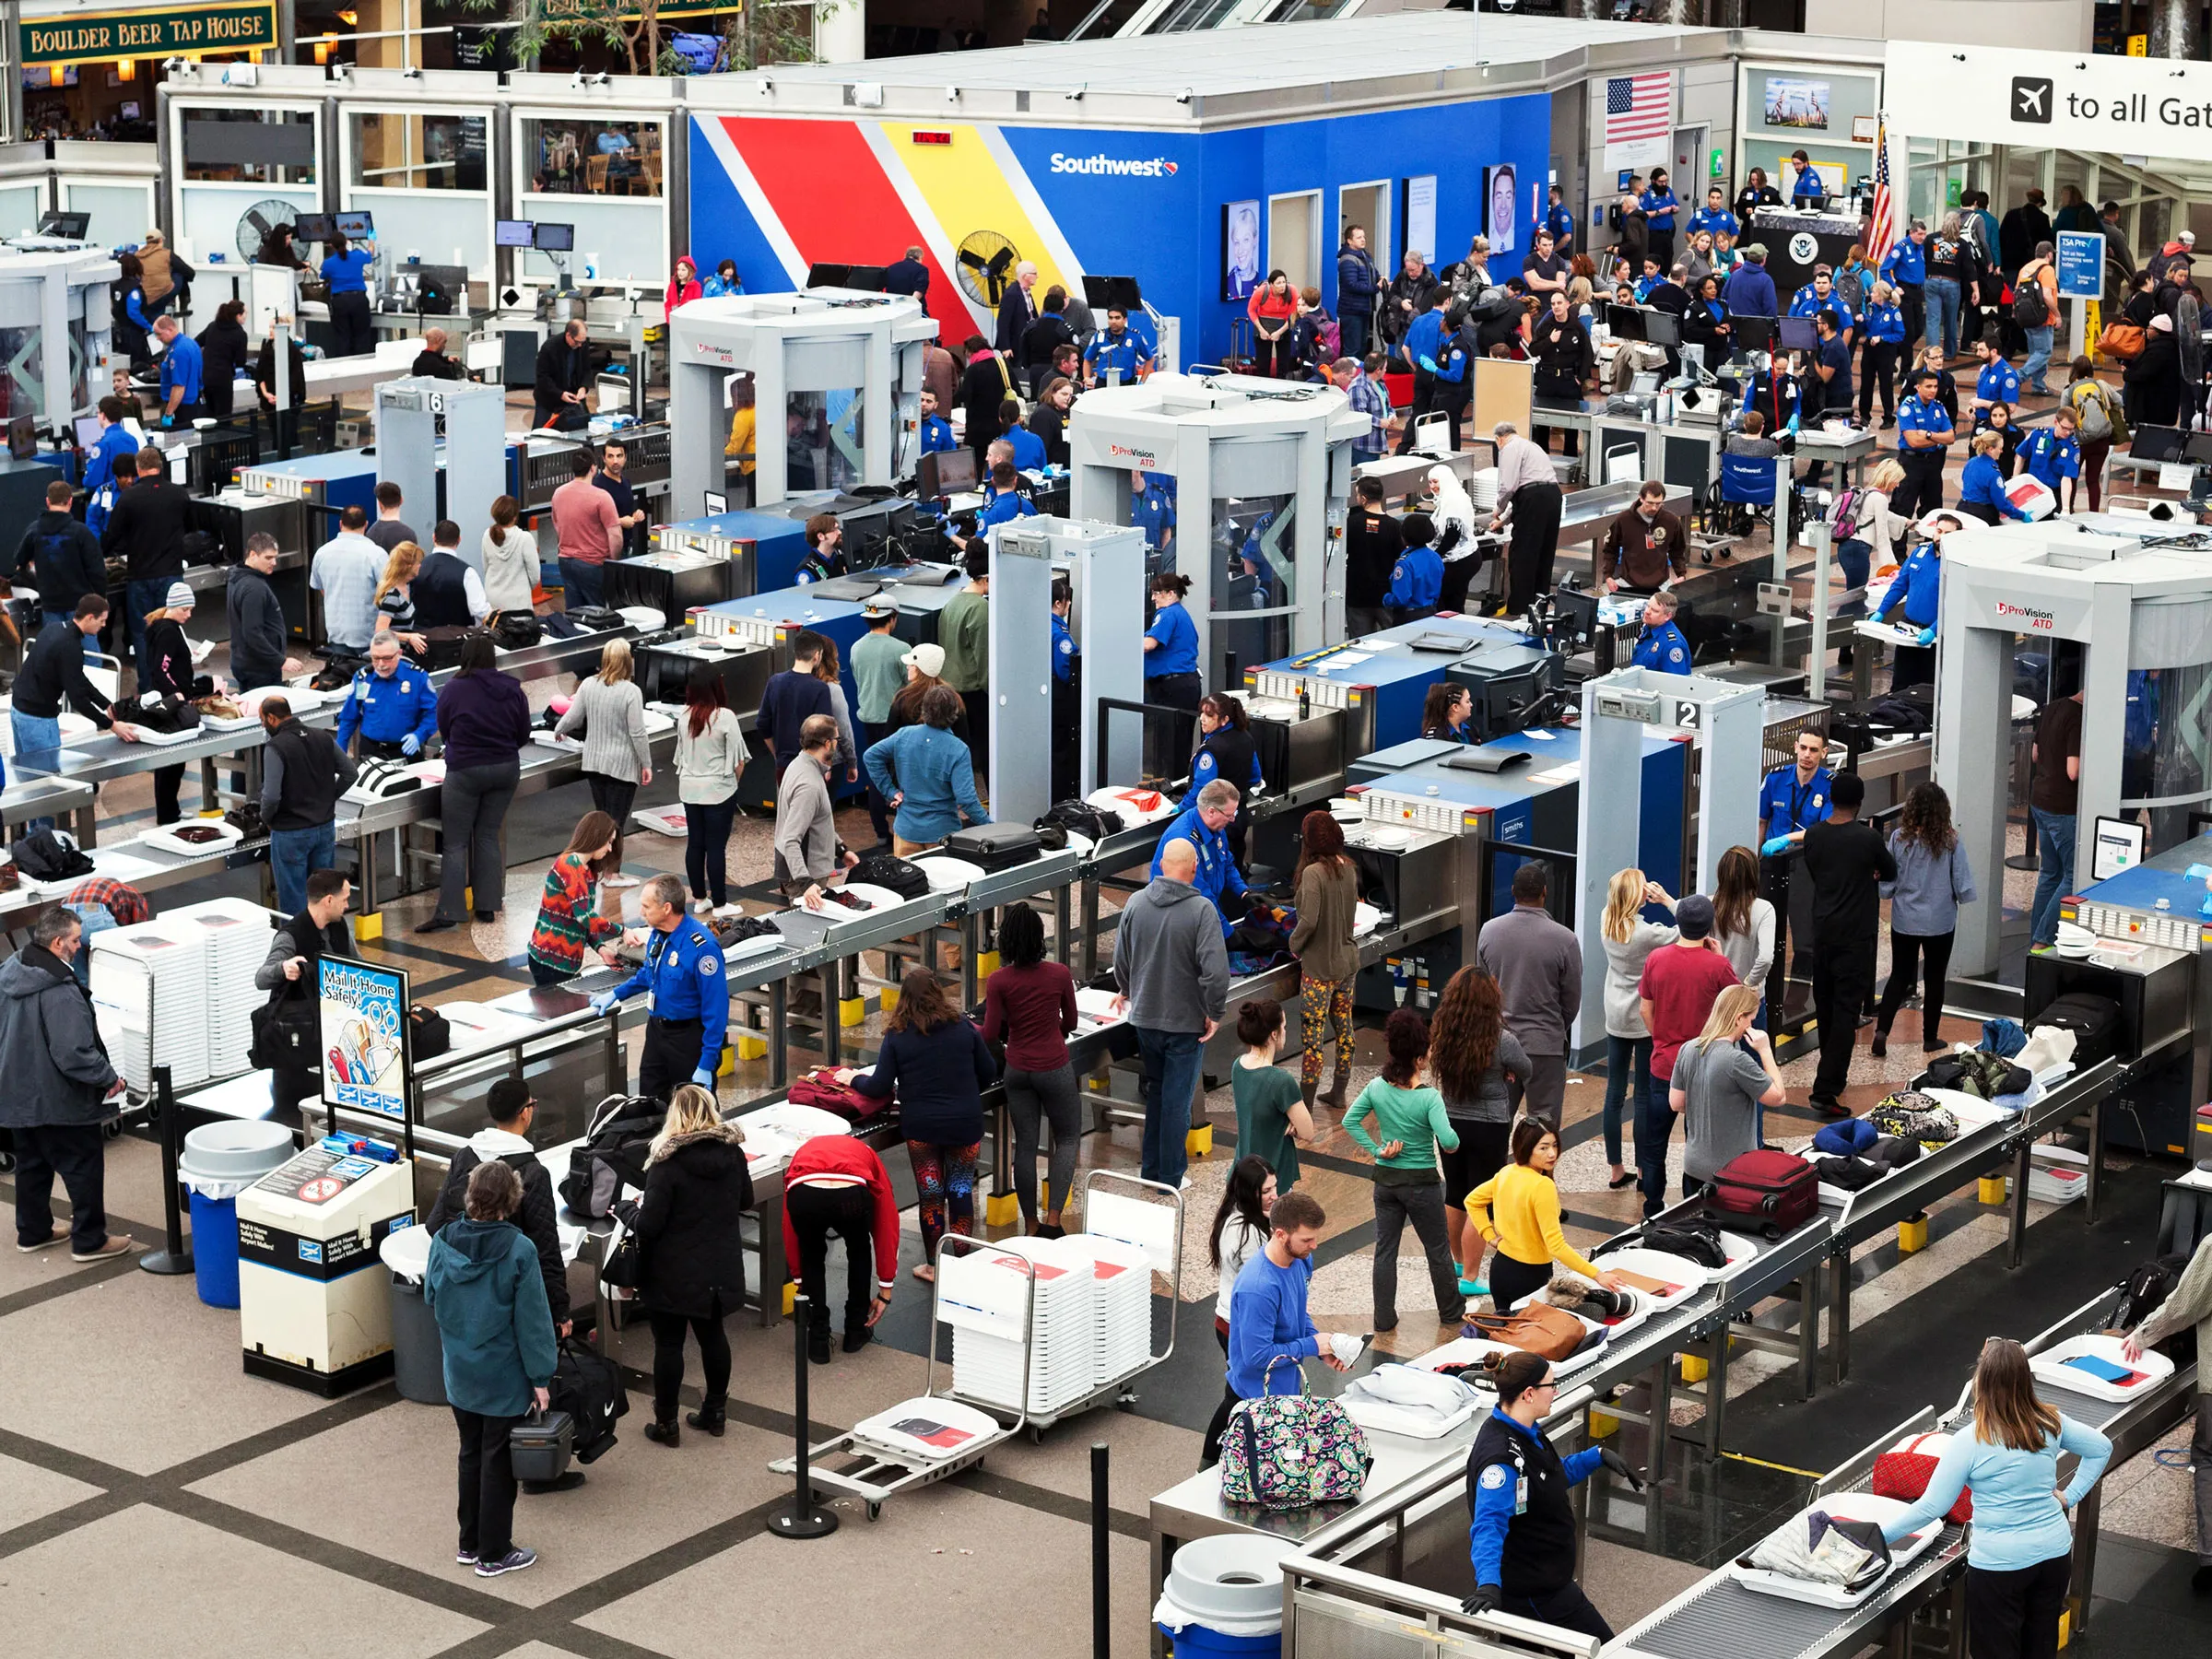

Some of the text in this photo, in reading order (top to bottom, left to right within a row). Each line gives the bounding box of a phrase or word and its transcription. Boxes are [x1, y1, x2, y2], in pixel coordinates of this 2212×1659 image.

[30, 16, 265, 53] BOULDER BEER TAP HOUSE
[2066, 92, 2212, 129] to all Gat
[1050, 152, 1163, 177] Southwest
[2062, 238, 2075, 247] TSA
[704, 345, 733, 355] ProVision
[430, 393, 442, 412] 6
[1119, 446, 1155, 459] ProVision
[1140, 458, 1155, 467] ATD
[2008, 605, 2053, 619] ProVision
[2032, 618, 2053, 629] ATD
[1679, 701, 1697, 728] 2
[324, 969, 394, 998] Mail It Home
[325, 985, 361, 1009] Safely!
[241, 1236, 257, 1246] Airport
[328, 1252, 346, 1264] Airport
